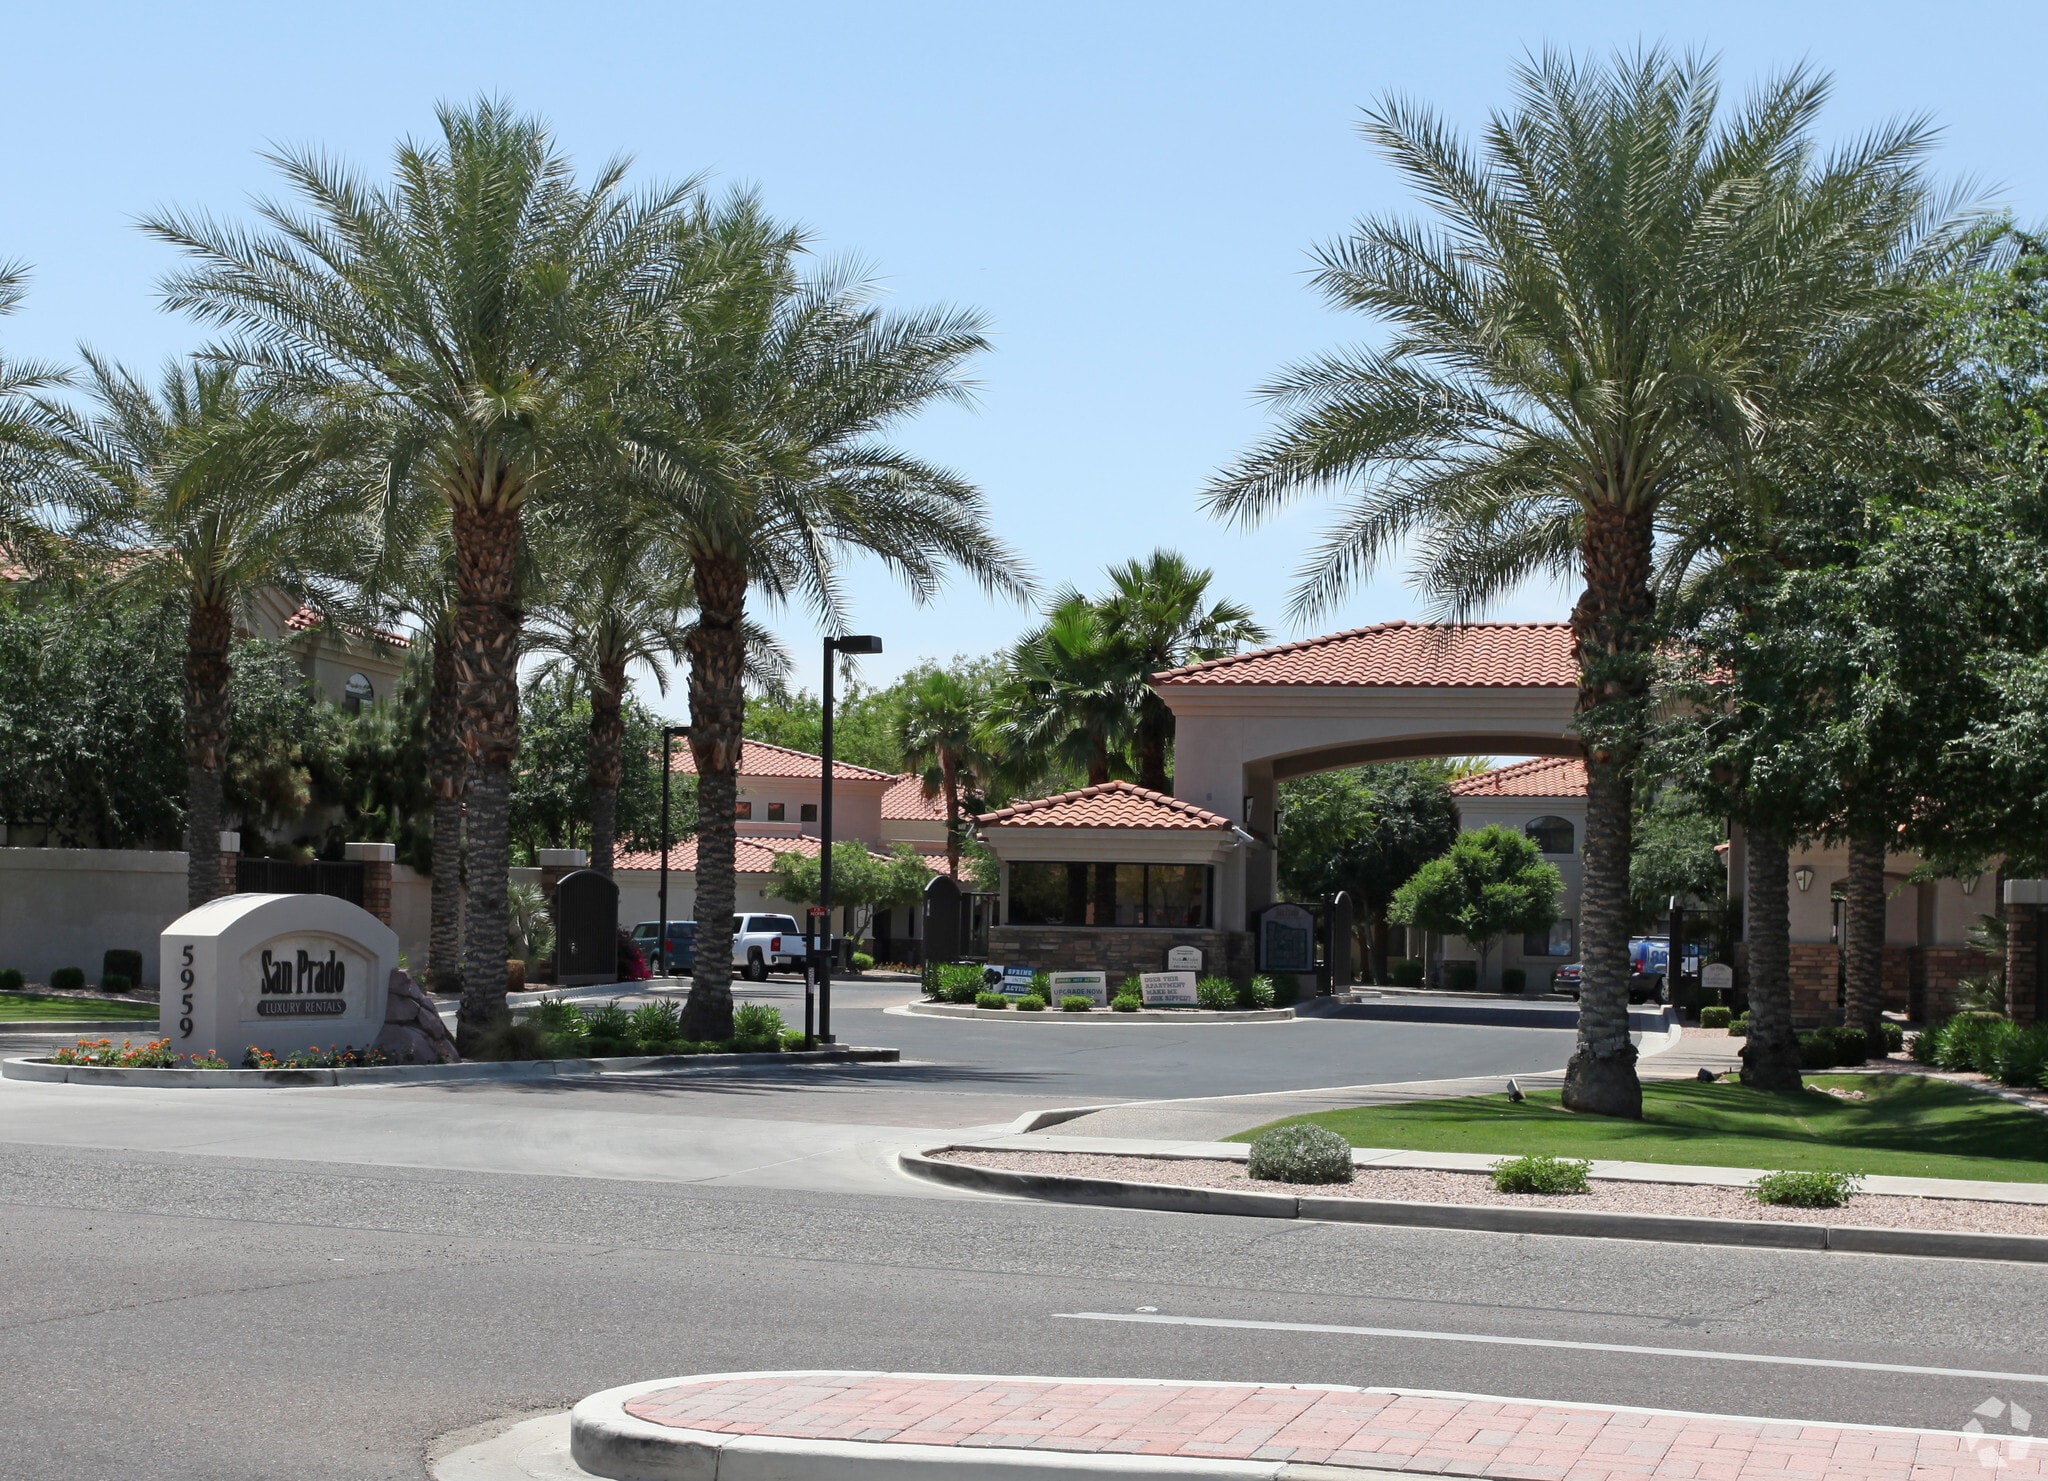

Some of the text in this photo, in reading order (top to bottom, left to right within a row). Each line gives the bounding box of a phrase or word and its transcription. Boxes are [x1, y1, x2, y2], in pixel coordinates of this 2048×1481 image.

[261, 950, 346, 994] San Prado
[1007, 968, 1033, 976] SPRING
[179, 945, 195, 1039] 5959
[1053, 988, 1085, 996] UPGRADE
[265, 1001, 342, 1014] LUXURY RENTALS
